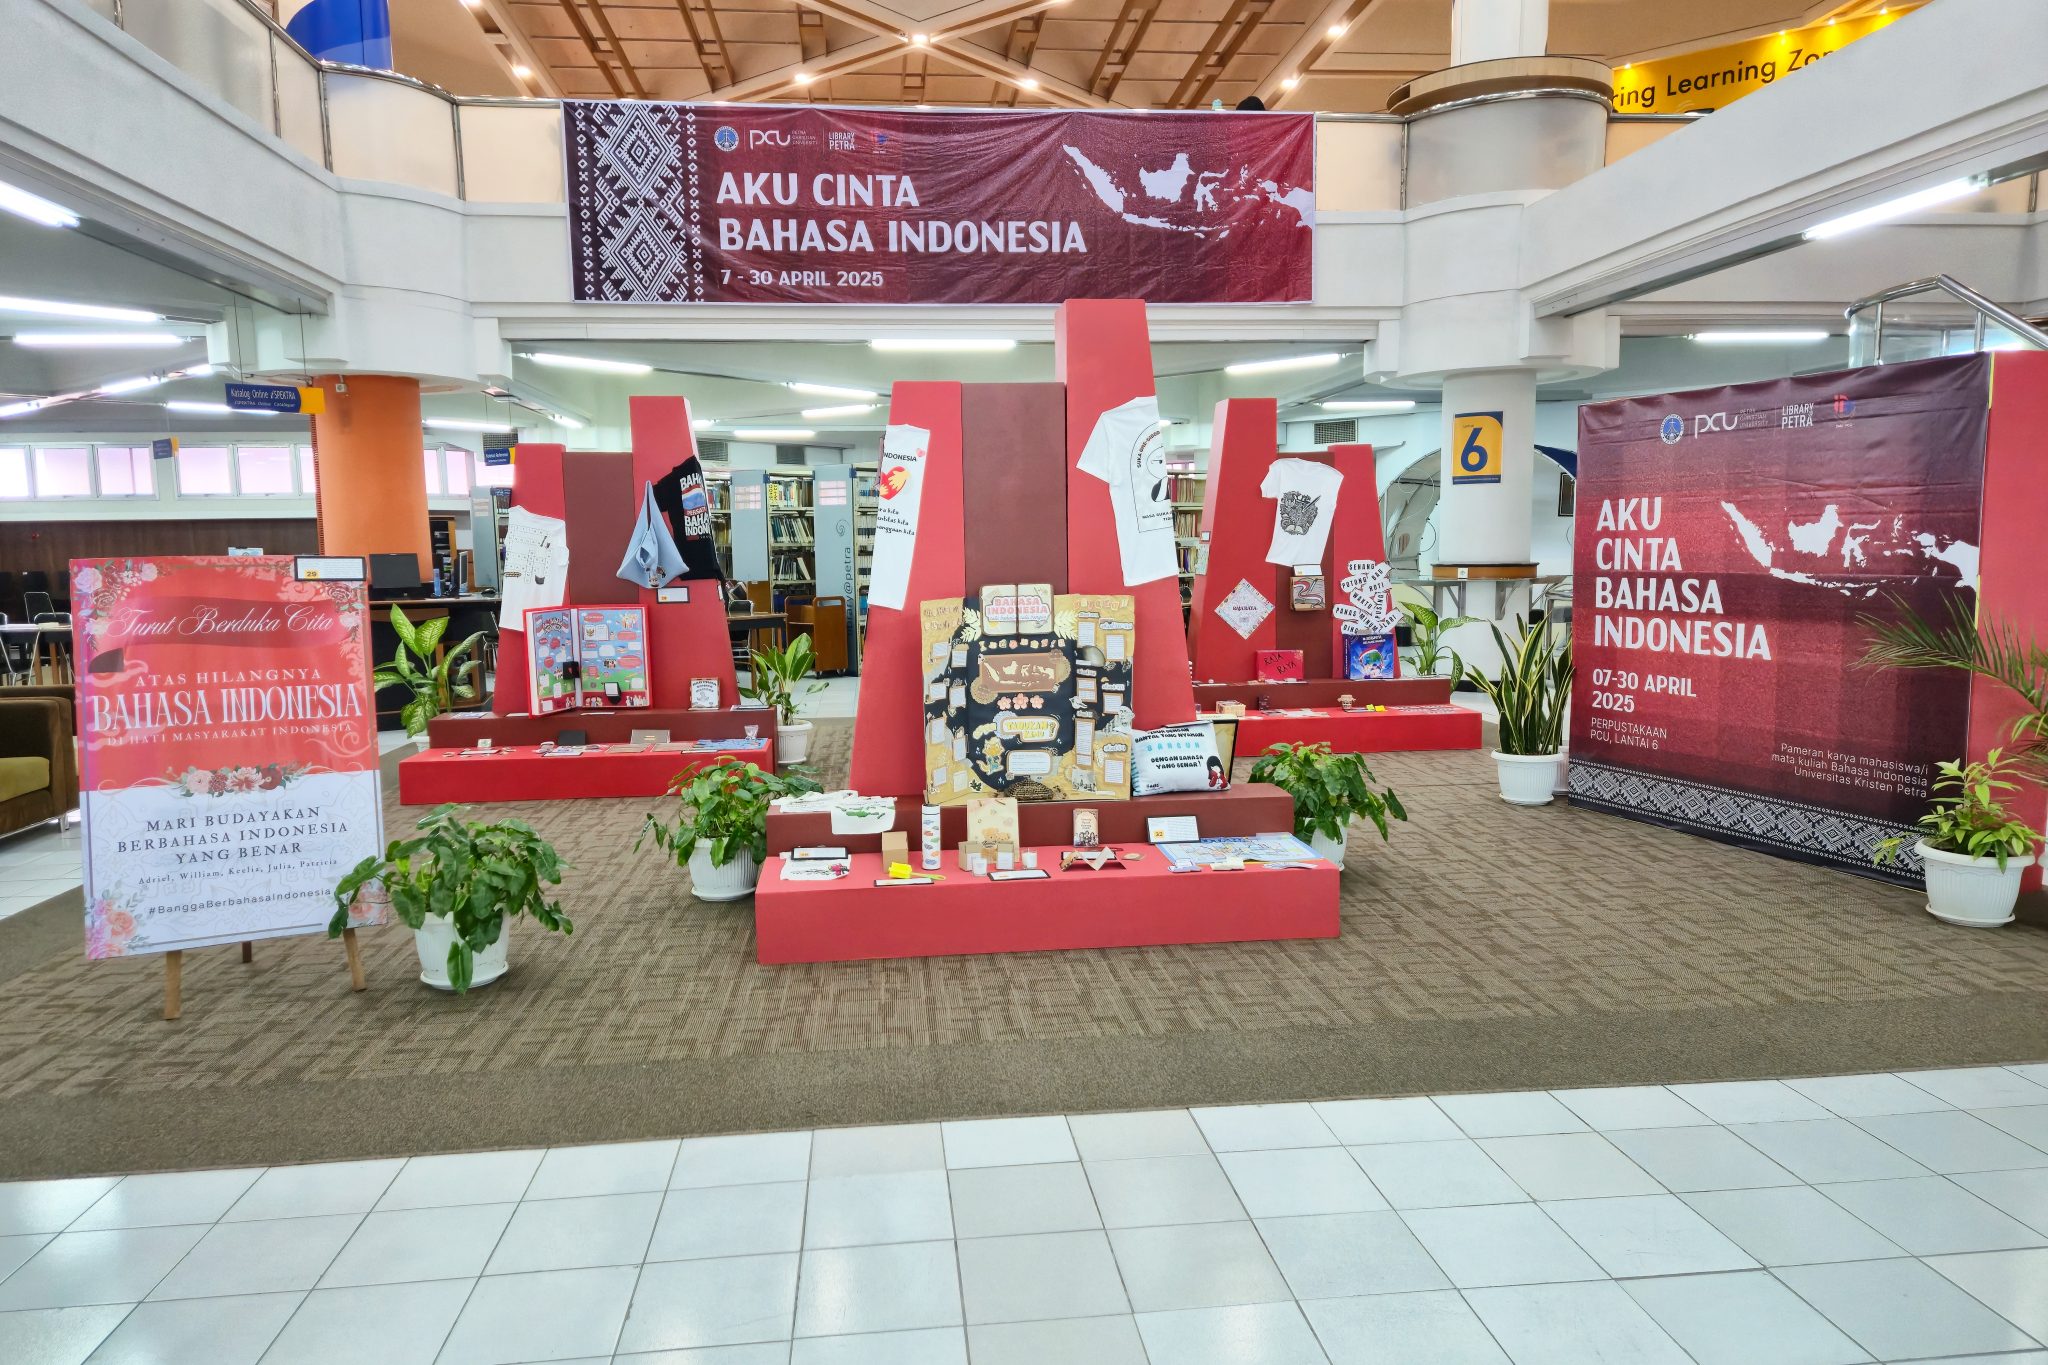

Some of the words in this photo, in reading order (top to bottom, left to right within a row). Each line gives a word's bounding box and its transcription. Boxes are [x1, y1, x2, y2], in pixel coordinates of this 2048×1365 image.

[1667, 60, 1776, 97] Learning
[828, 131, 855, 140] LIBRARY
[829, 140, 856, 151] PETRA
[716, 171, 799, 205] AKU
[812, 173, 920, 207] CINTA
[718, 217, 874, 252] BAHASA
[888, 220, 1088, 253] INDONESIA
[720, 269, 731, 285] 7
[750, 270, 773, 286] 30
[779, 270, 831, 287] APRIL
[837, 271, 884, 287] 2025
[1781, 415, 1813, 429] PETRA
[1782, 402, 1814, 416] LIBRARY
[1461, 427, 1489, 472] 6
[1596, 496, 1662, 532] AKU
[1349, 563, 1375, 571] SENANG
[1595, 537, 1682, 571] CINTA
[1341, 576, 1367, 589] POTONG
[1368, 582, 1385, 592] ROTI
[1595, 577, 1724, 614] BAHASA
[106, 606, 177, 638] Turut
[178, 604, 281, 636] Berduka
[284, 603, 334, 632] Cita
[1335, 607, 1357, 617] PANAS
[1594, 614, 1772, 661] INDONESIA
[135, 673, 187, 688] ATAS
[196, 668, 321, 684] HILANGNYA
[1592, 668, 1639, 690] 07-30
[1644, 674, 1697, 698] APRIL
[92, 689, 213, 732] BAHASA
[221, 683, 363, 724] INDONESIA
[1591, 690, 1635, 713] 2025
[130, 734, 166, 745] HATI
[172, 727, 267, 742] MASYARAKAT
[272, 723, 352, 736] INDONESIA
[1590, 729, 1612, 744] PCU,
[1615, 733, 1649, 749] LANTAI
[1651, 739, 1659, 750] 6
[1591, 717, 1667, 739] PERPUSTAKAAN
[1771, 753, 1795, 764] mata
[1798, 757, 1828, 769] kuliah
[1831, 762, 1869, 777] Bahasa
[1873, 768, 1928, 787] Indonesia
[1781, 742, 1824, 758] Pameran
[1827, 749, 1856, 763] karya
[1859, 756, 1929, 775] mahasiswa/i
[1794, 766, 1851, 784] Universitas
[1854, 777, 1893, 792] Kristen
[1897, 784, 1927, 798] Petra
[146, 817, 197, 832] MARI
[205, 806, 321, 827] BUDAYAKAN
[117, 832, 232, 853] BERBAHASA
[240, 822, 348, 841] INDONESIA
[176, 849, 230, 865] YANG
[239, 842, 303, 858] BENAR
[179, 870, 224, 880] William,
[267, 862, 295, 872] Julia,
[300, 858, 337, 868] Patricia
[149, 888, 331, 915] #BanggaBerbahasaIndonesia
